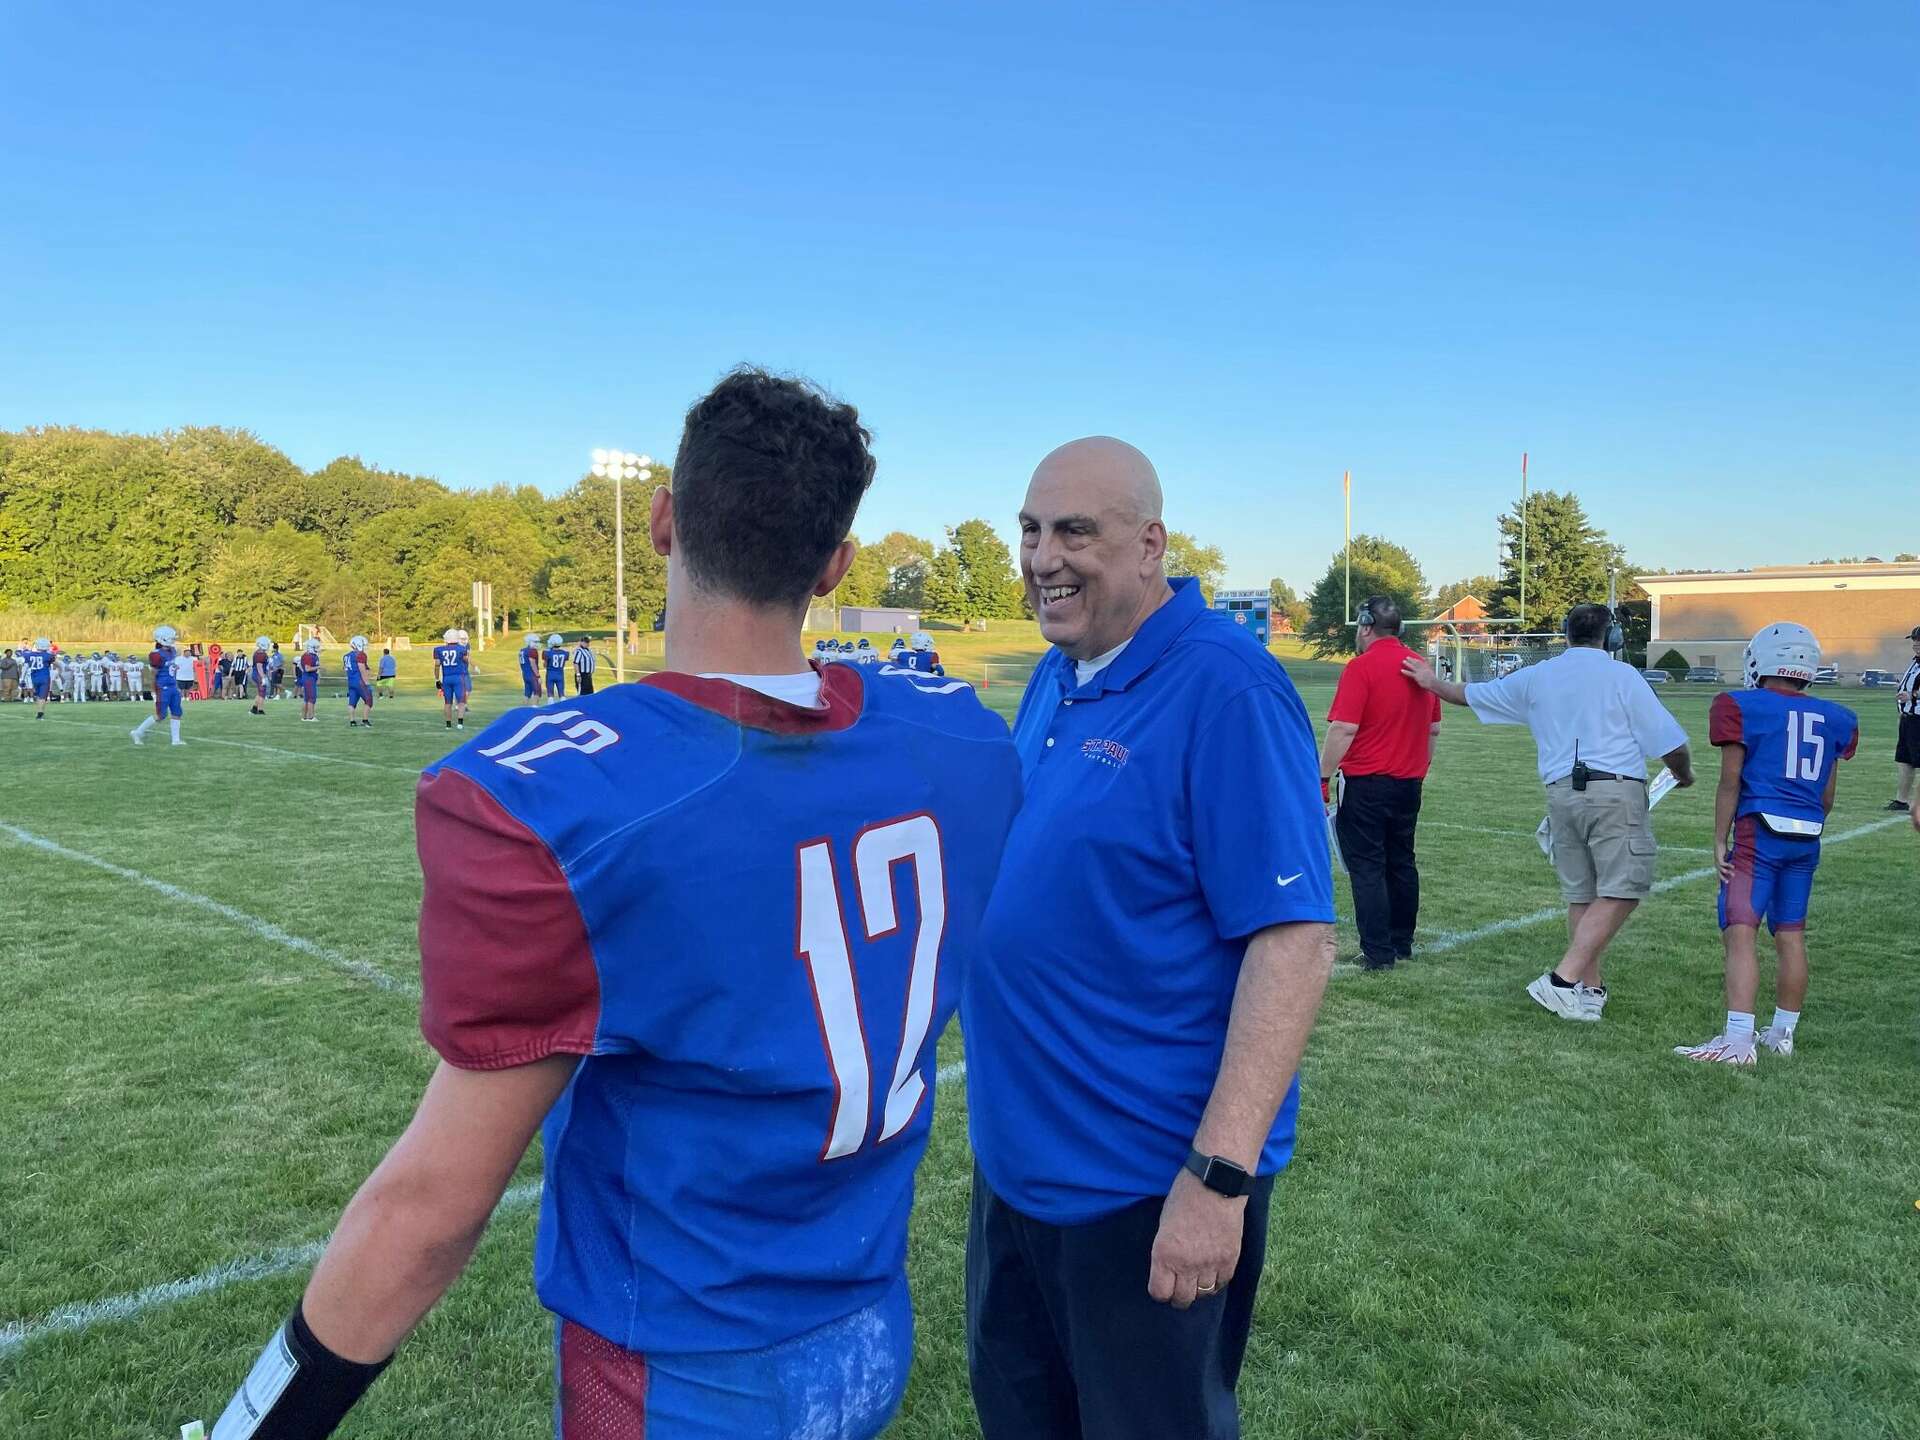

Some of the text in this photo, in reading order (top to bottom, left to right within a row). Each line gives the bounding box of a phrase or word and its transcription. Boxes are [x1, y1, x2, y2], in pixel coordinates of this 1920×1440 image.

[31, 655, 44, 670] 28
[442, 650, 458, 666] 32
[552, 654, 565, 668] 87
[477, 710, 618, 775] 12
[1785, 710, 1825, 782] 15
[797, 812, 946, 1162] 12
